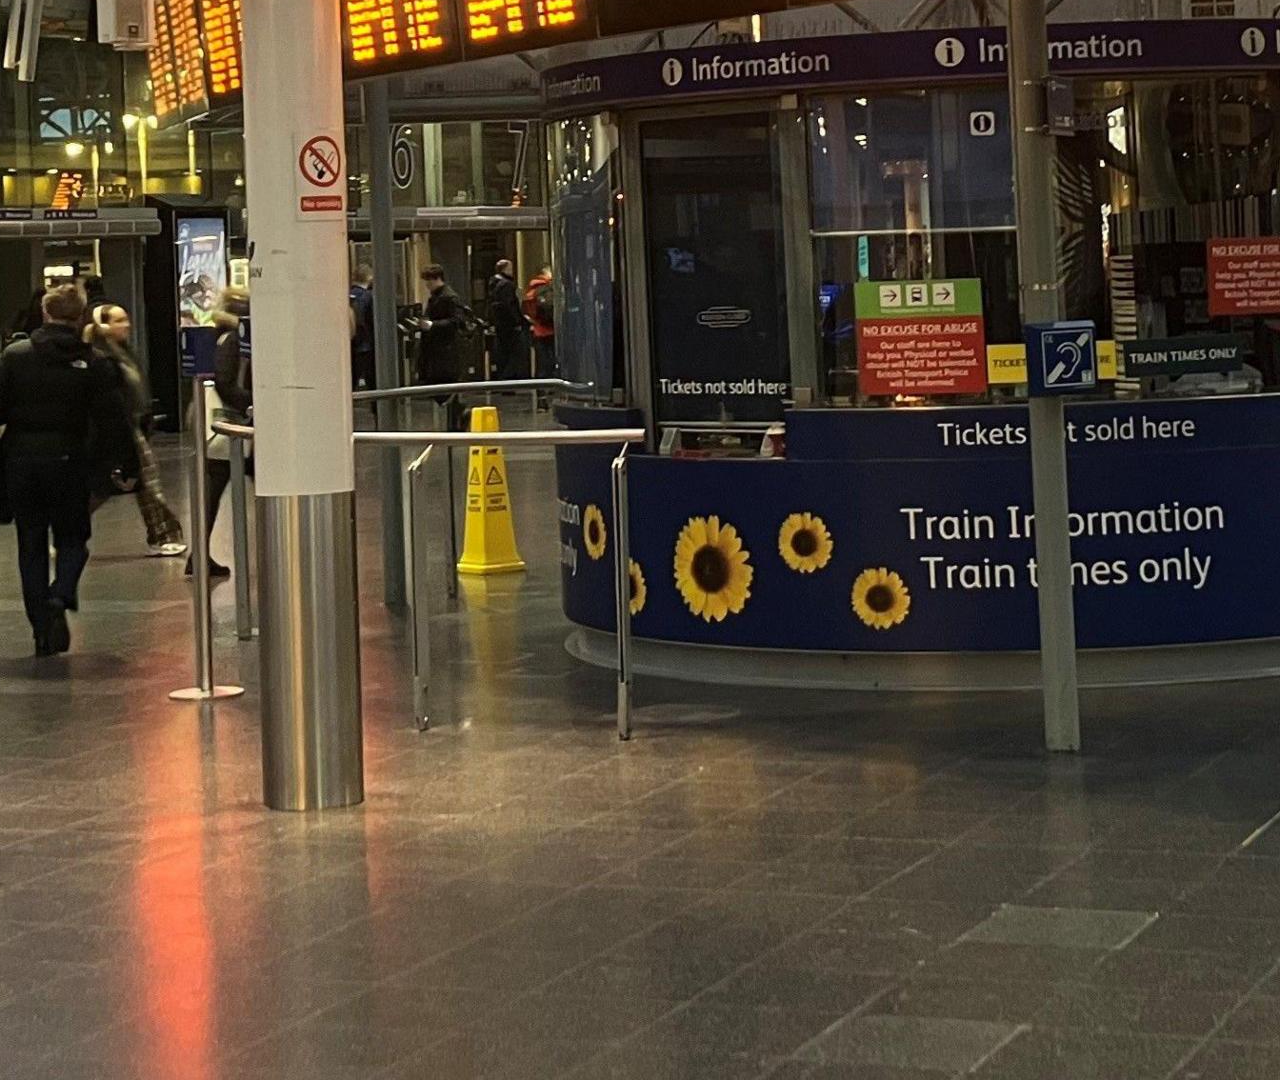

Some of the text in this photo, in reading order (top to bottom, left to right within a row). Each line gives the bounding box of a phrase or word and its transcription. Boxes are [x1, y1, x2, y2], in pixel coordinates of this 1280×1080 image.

[979, 35, 1143, 64] Inmation
[692, 51, 830, 81] Information
[863, 322, 977, 336] NO EXCUSE FOR ABUSE
[906, 359, 925, 368] NOT
[1129, 347, 1237, 364] TRAIN TIMES ONLY
[659, 378, 787, 395] Tickets not sold here
[937, 421, 1027, 445] Tickets
[1084, 417, 1134, 441] sold
[1142, 416, 1196, 439] here
[900, 508, 994, 540] Train
[920, 557, 1015, 589] Train
[1139, 547, 1212, 590] only
